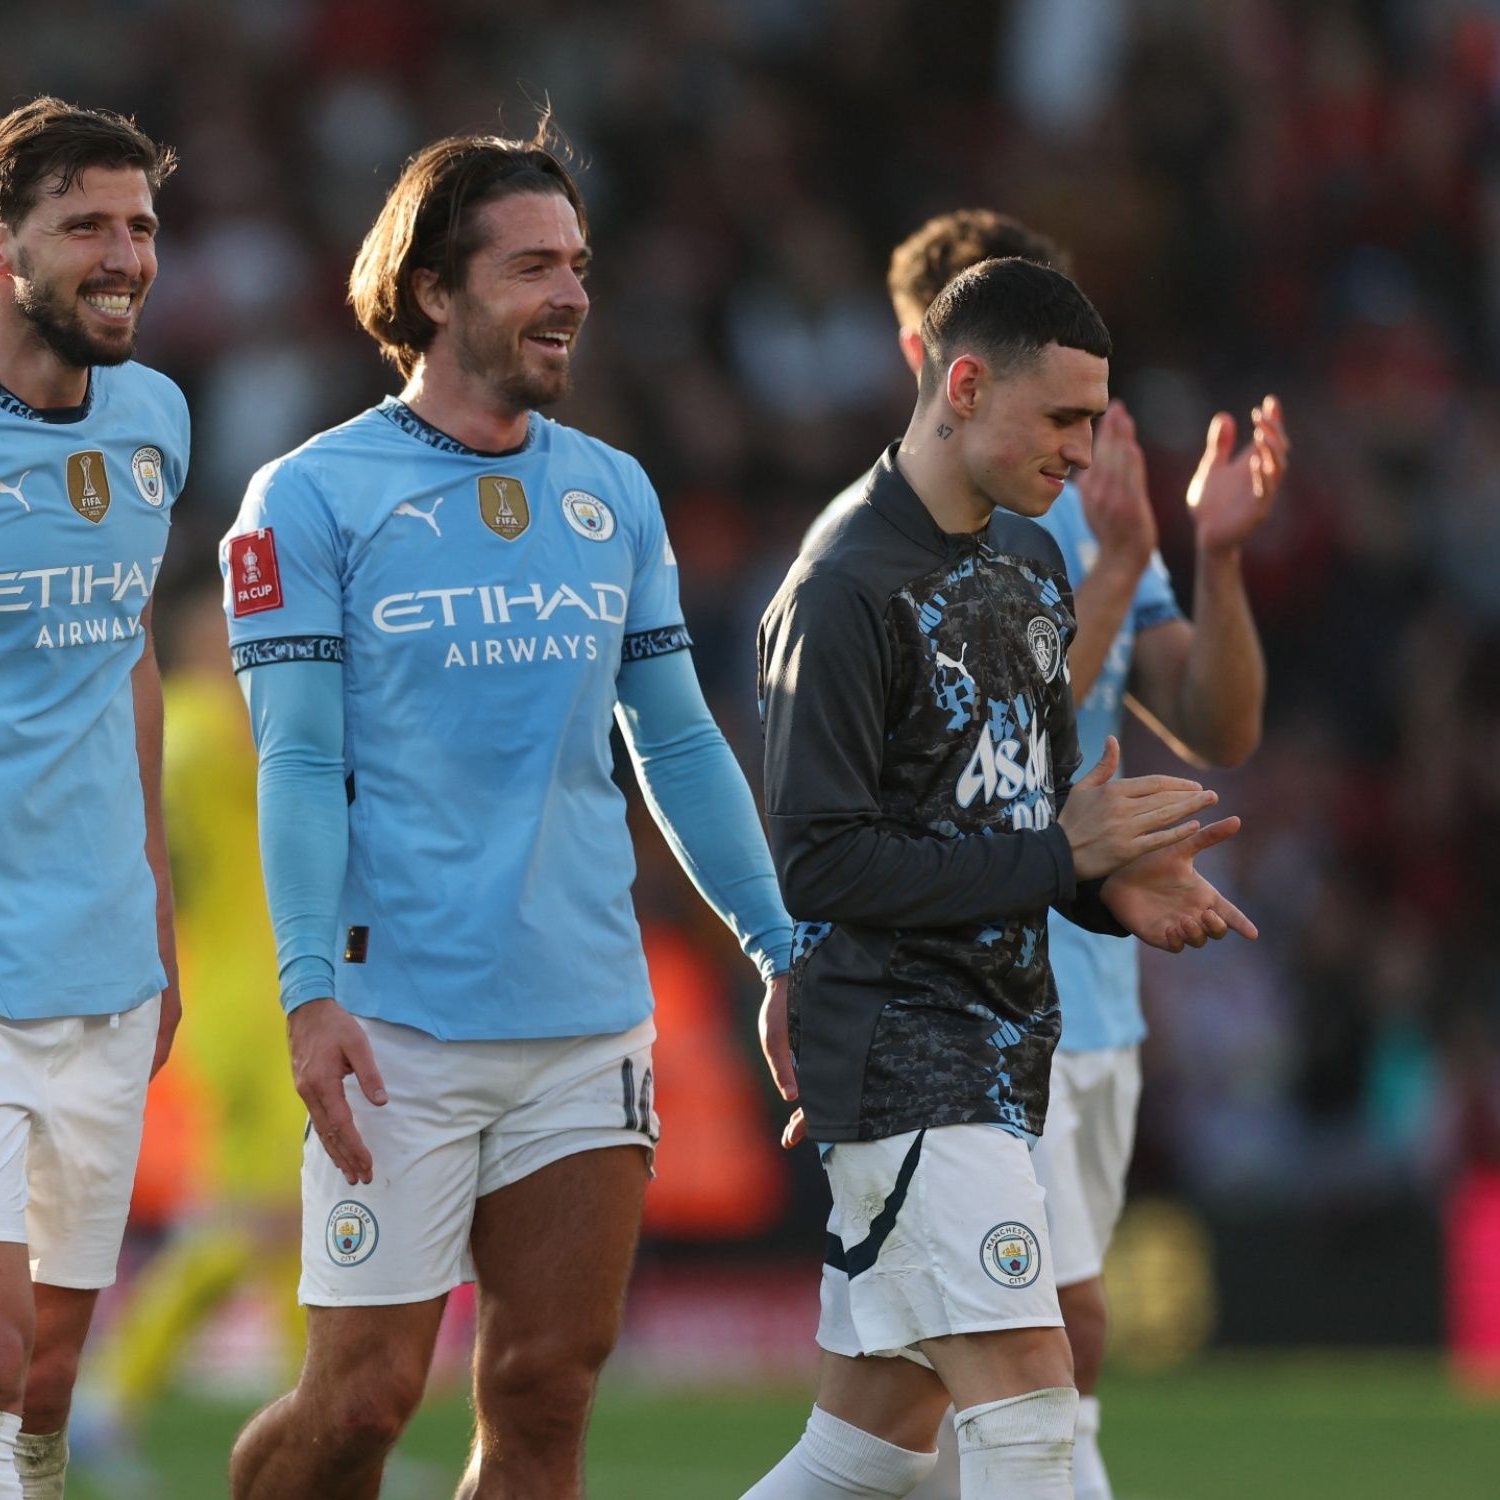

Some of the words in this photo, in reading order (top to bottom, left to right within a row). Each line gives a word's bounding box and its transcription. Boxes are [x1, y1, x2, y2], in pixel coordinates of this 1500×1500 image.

[936, 424, 953, 440] 47
[81, 496, 102, 507] FIFA
[495, 516, 519, 525] FIFA
[237, 591, 250, 602] FA
[249, 584, 273, 599] CUP
[372, 582, 627, 633] ETIHAD
[34, 615, 145, 649] AIRWAY
[444, 635, 597, 668] AIRWAYS
[330, 1205, 370, 1226] MANCHESTER
[986, 1227, 1033, 1250] MANCHESTER
[1009, 1276, 1026, 1284] CITY
